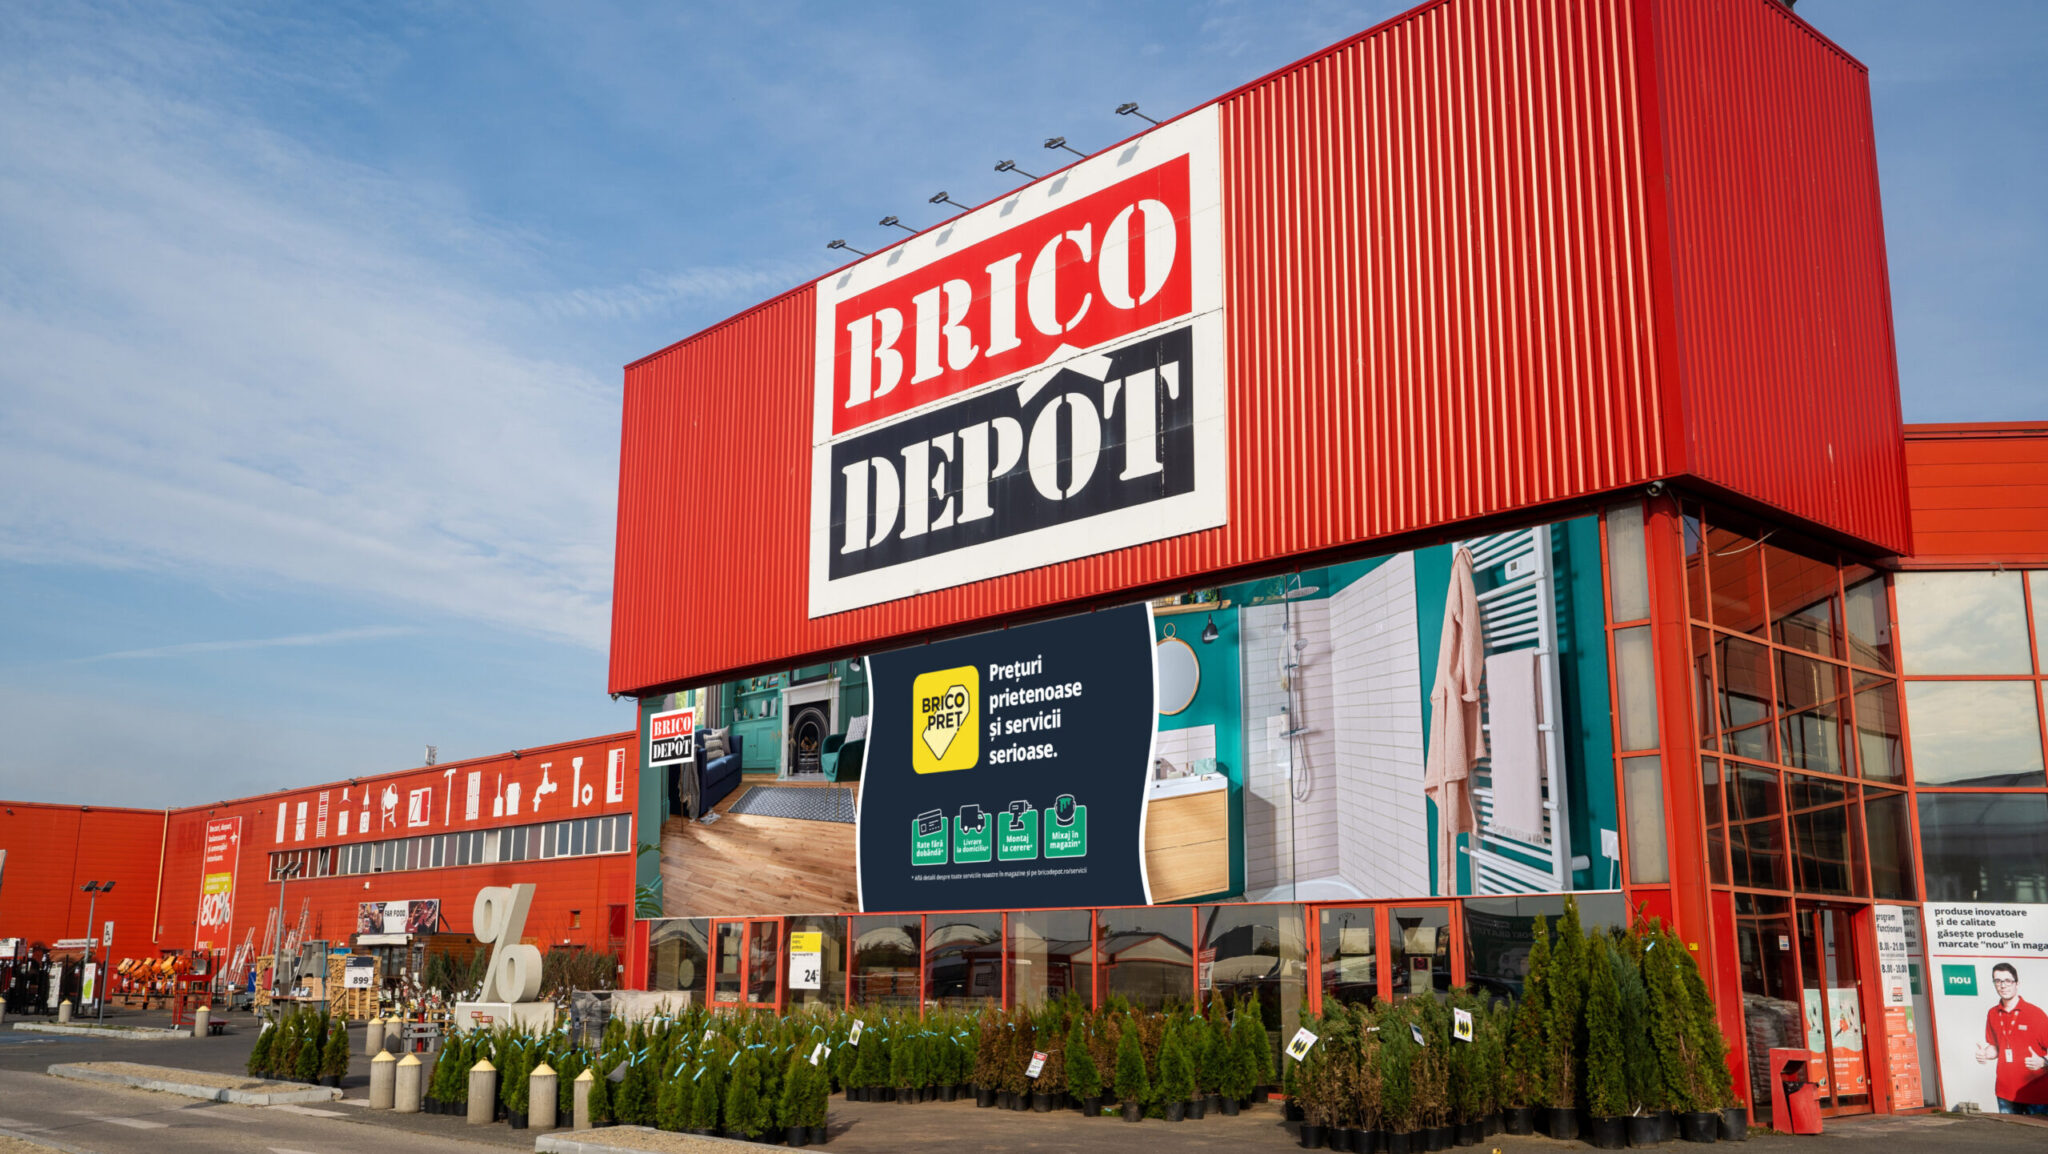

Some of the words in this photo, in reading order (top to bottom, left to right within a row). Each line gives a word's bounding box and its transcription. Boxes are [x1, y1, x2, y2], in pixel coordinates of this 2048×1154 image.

[845, 199, 1177, 408] BRICO
[841, 343, 1180, 554] DEPÔT
[989, 654, 1042, 682] Prețuri
[922, 692, 965, 713] BRICO
[989, 681, 1082, 714] prietenoase
[654, 716, 691, 736] BRICO
[989, 716, 1002, 742] și
[1005, 708, 1061, 735] servicii
[653, 734, 691, 759] DEPÔT
[989, 742, 1058, 765] serioase.
[1006, 834, 1029, 843] Montaj
[1052, 831, 1071, 840] Mixaj
[917, 841, 930, 849] Rate
[1002, 844, 1008, 852] la
[201, 891, 231, 927] 80%
[1934, 907, 1973, 917] produse
[1975, 907, 2027, 917] inovatoare
[1936, 917, 1944, 927] și
[1946, 917, 1958, 926] de
[1960, 917, 1996, 927] calitate
[1937, 929, 1974, 939] găsește
[1976, 930, 2024, 940] produsele
[1938, 941, 1979, 949] marcate
[2010, 941, 2020, 949] în
[353, 976, 369, 985] 899
[804, 969, 816, 983] 24
[1949, 976, 1971, 985] nou
